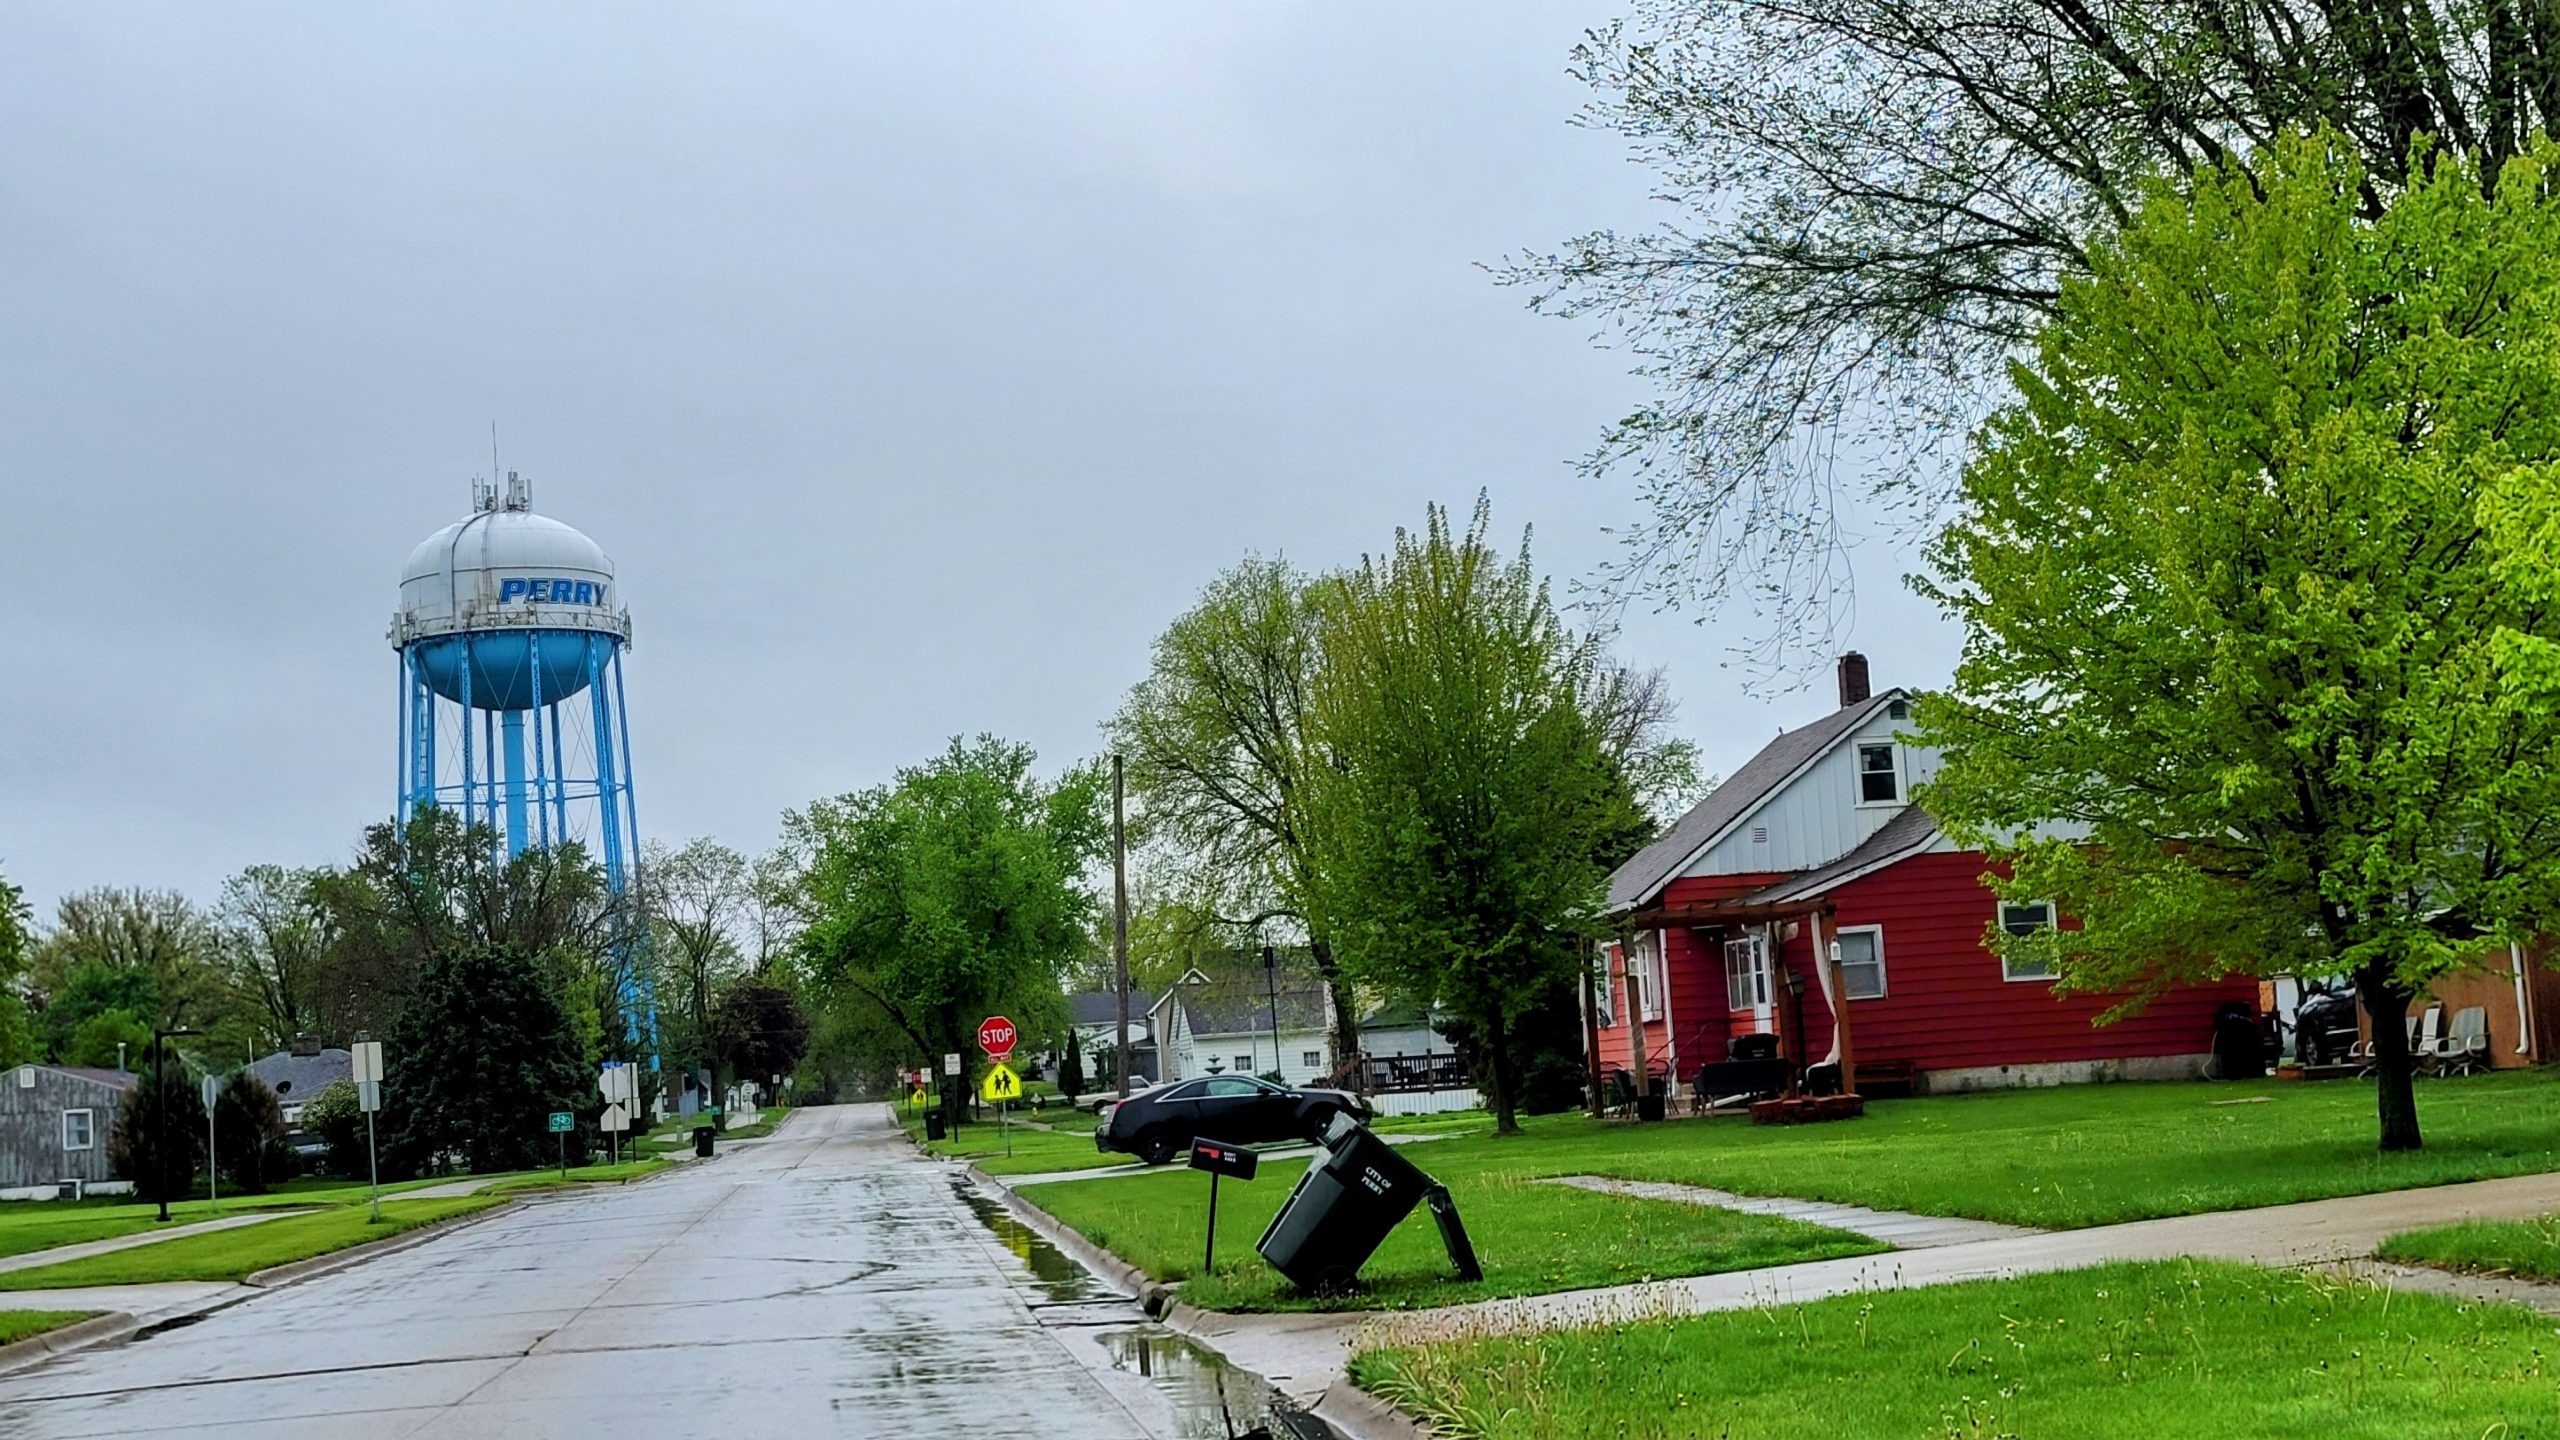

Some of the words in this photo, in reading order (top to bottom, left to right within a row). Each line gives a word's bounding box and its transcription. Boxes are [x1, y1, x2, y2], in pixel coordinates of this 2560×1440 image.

[497, 577, 608, 607] PERRY
[981, 1027, 1013, 1045] STOP
[1361, 1175, 1383, 1195] PERRY
[1365, 1166, 1382, 1182] CITY
[1381, 1178, 1392, 1189] OF
